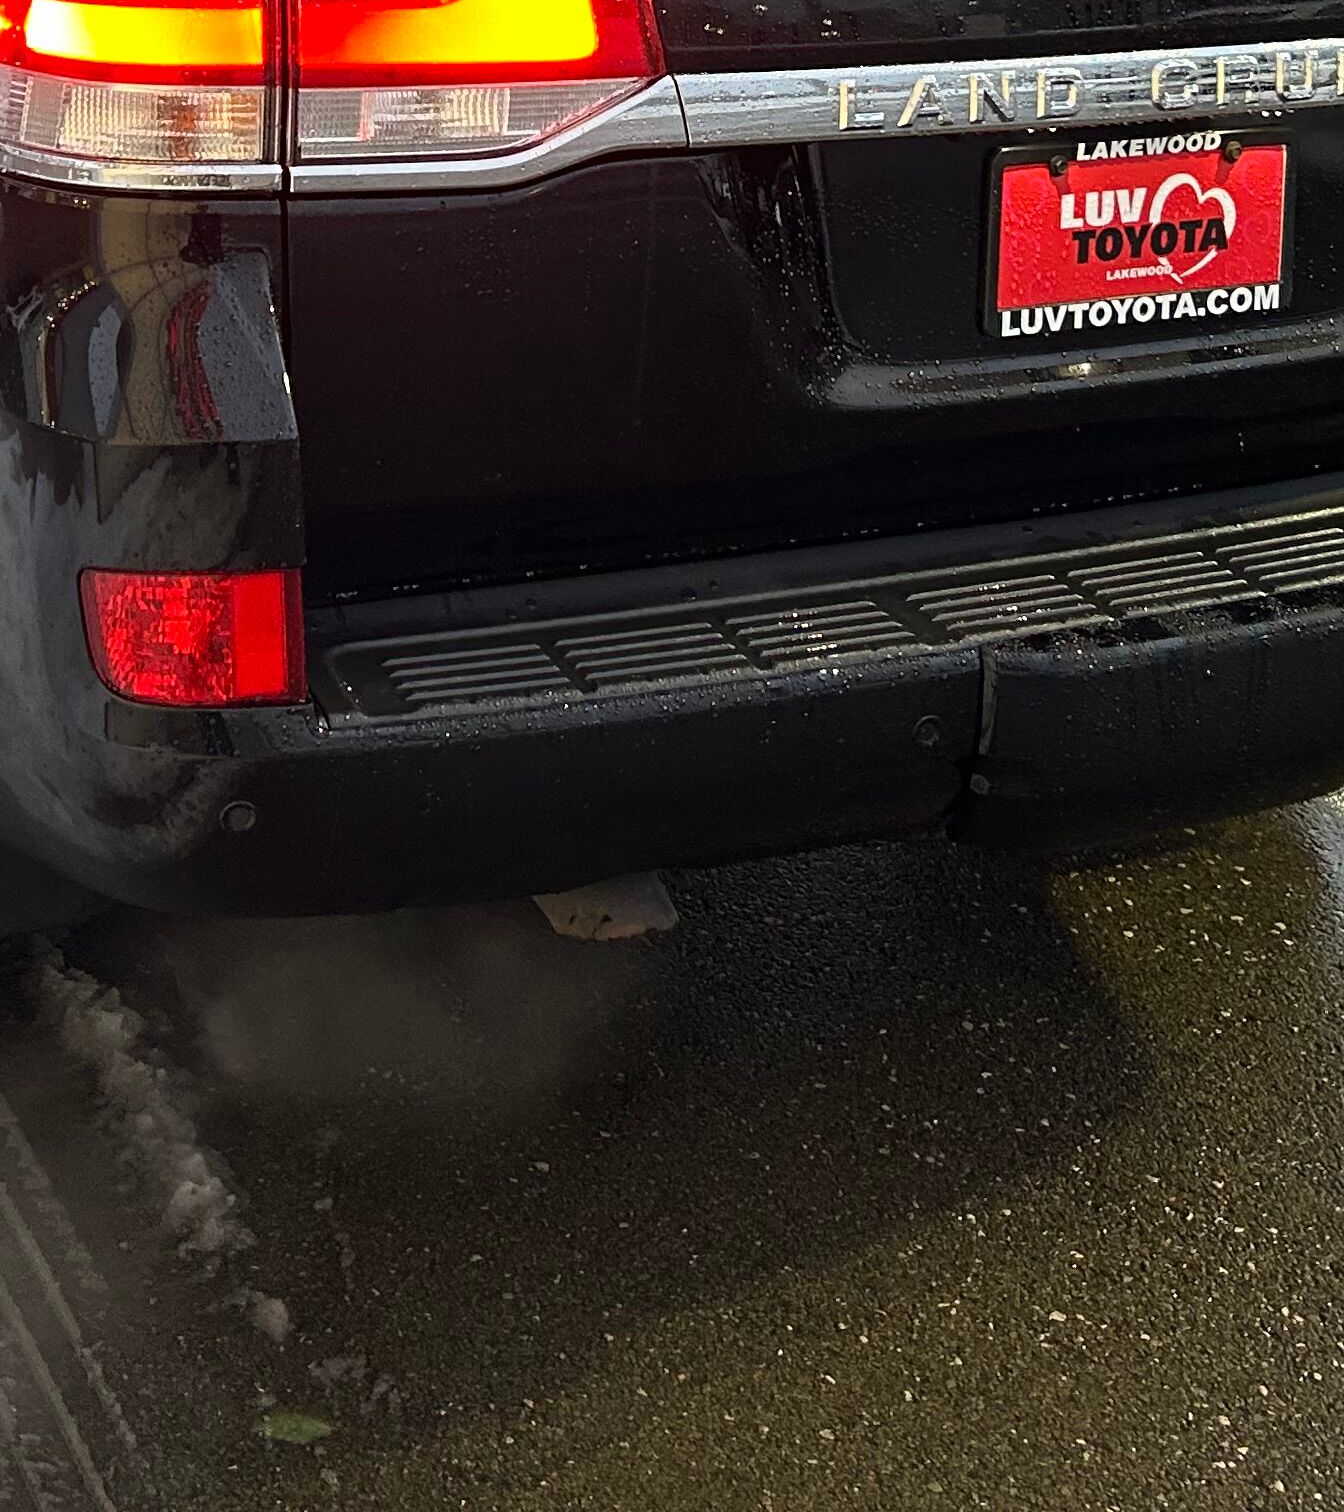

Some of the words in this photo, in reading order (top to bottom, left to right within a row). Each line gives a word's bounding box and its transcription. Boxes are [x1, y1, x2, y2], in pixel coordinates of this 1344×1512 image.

[838, 68, 1082, 131] LAND
[1076, 133, 1221, 161] LAKEWOOD
[1059, 187, 1147, 229] LUV
[1071, 218, 1228, 264] TOYOTA
[1105, 264, 1173, 281] LAKEWOOD
[1001, 284, 1281, 337] LUVTOYOTA.COM
